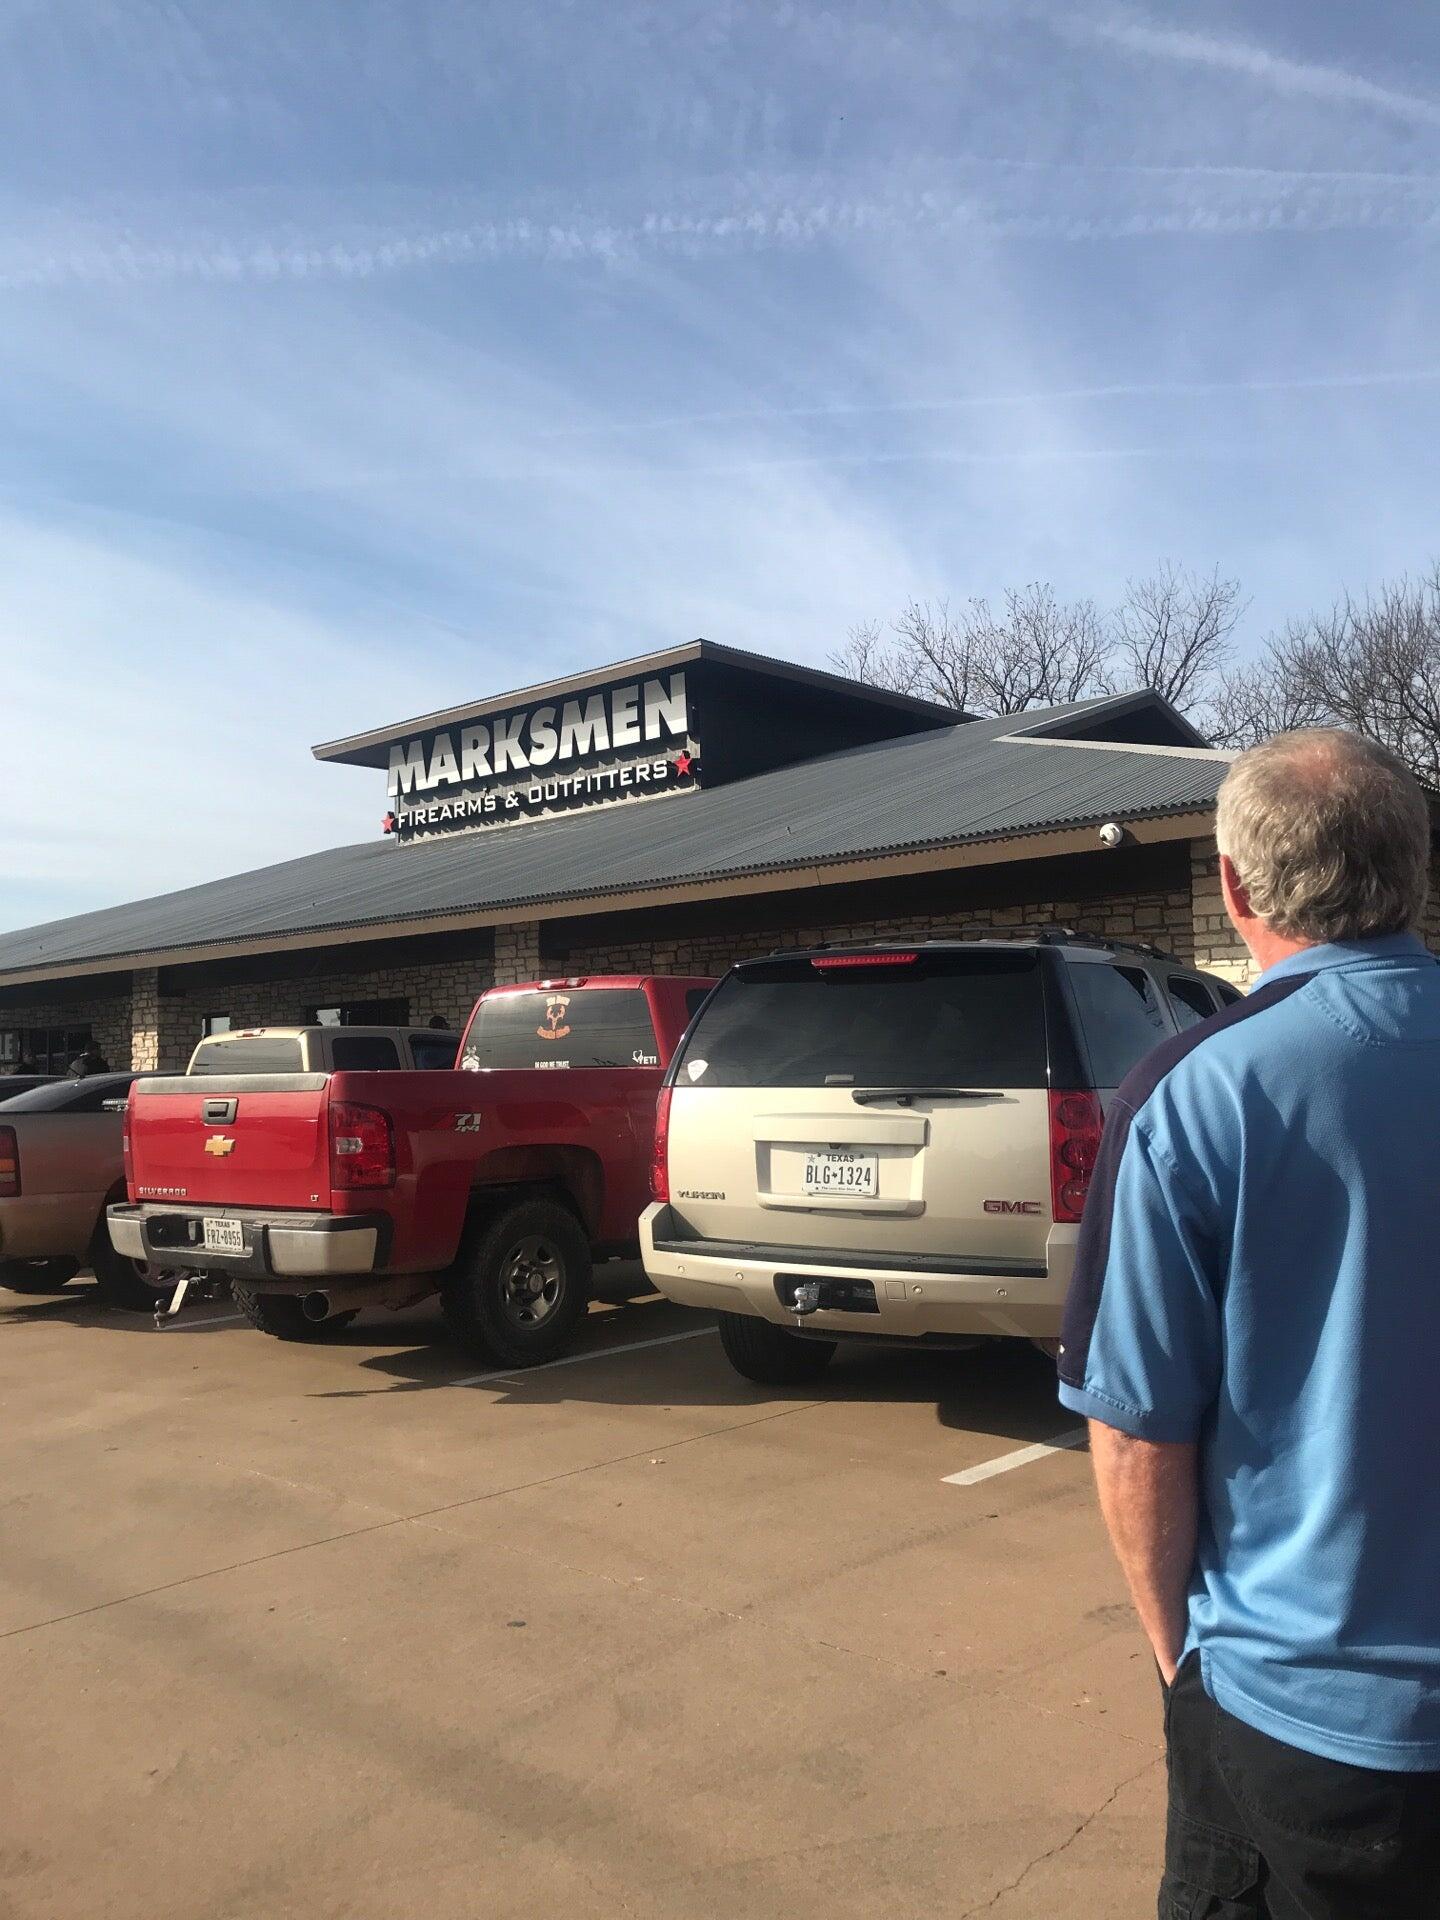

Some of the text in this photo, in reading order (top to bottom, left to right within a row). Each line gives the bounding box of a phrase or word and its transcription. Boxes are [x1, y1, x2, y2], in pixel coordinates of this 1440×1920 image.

[387, 672, 688, 797] MARKSMEN
[398, 760, 668, 829] FIREARMS & OUTFITTERS
[826, 1154, 855, 1162] TEXAS
[138, 1186, 187, 1196] SILVERADO
[677, 1190, 726, 1200] YUKON
[983, 1200, 1041, 1214] GMC
[215, 1220, 231, 1228] TEXAS
